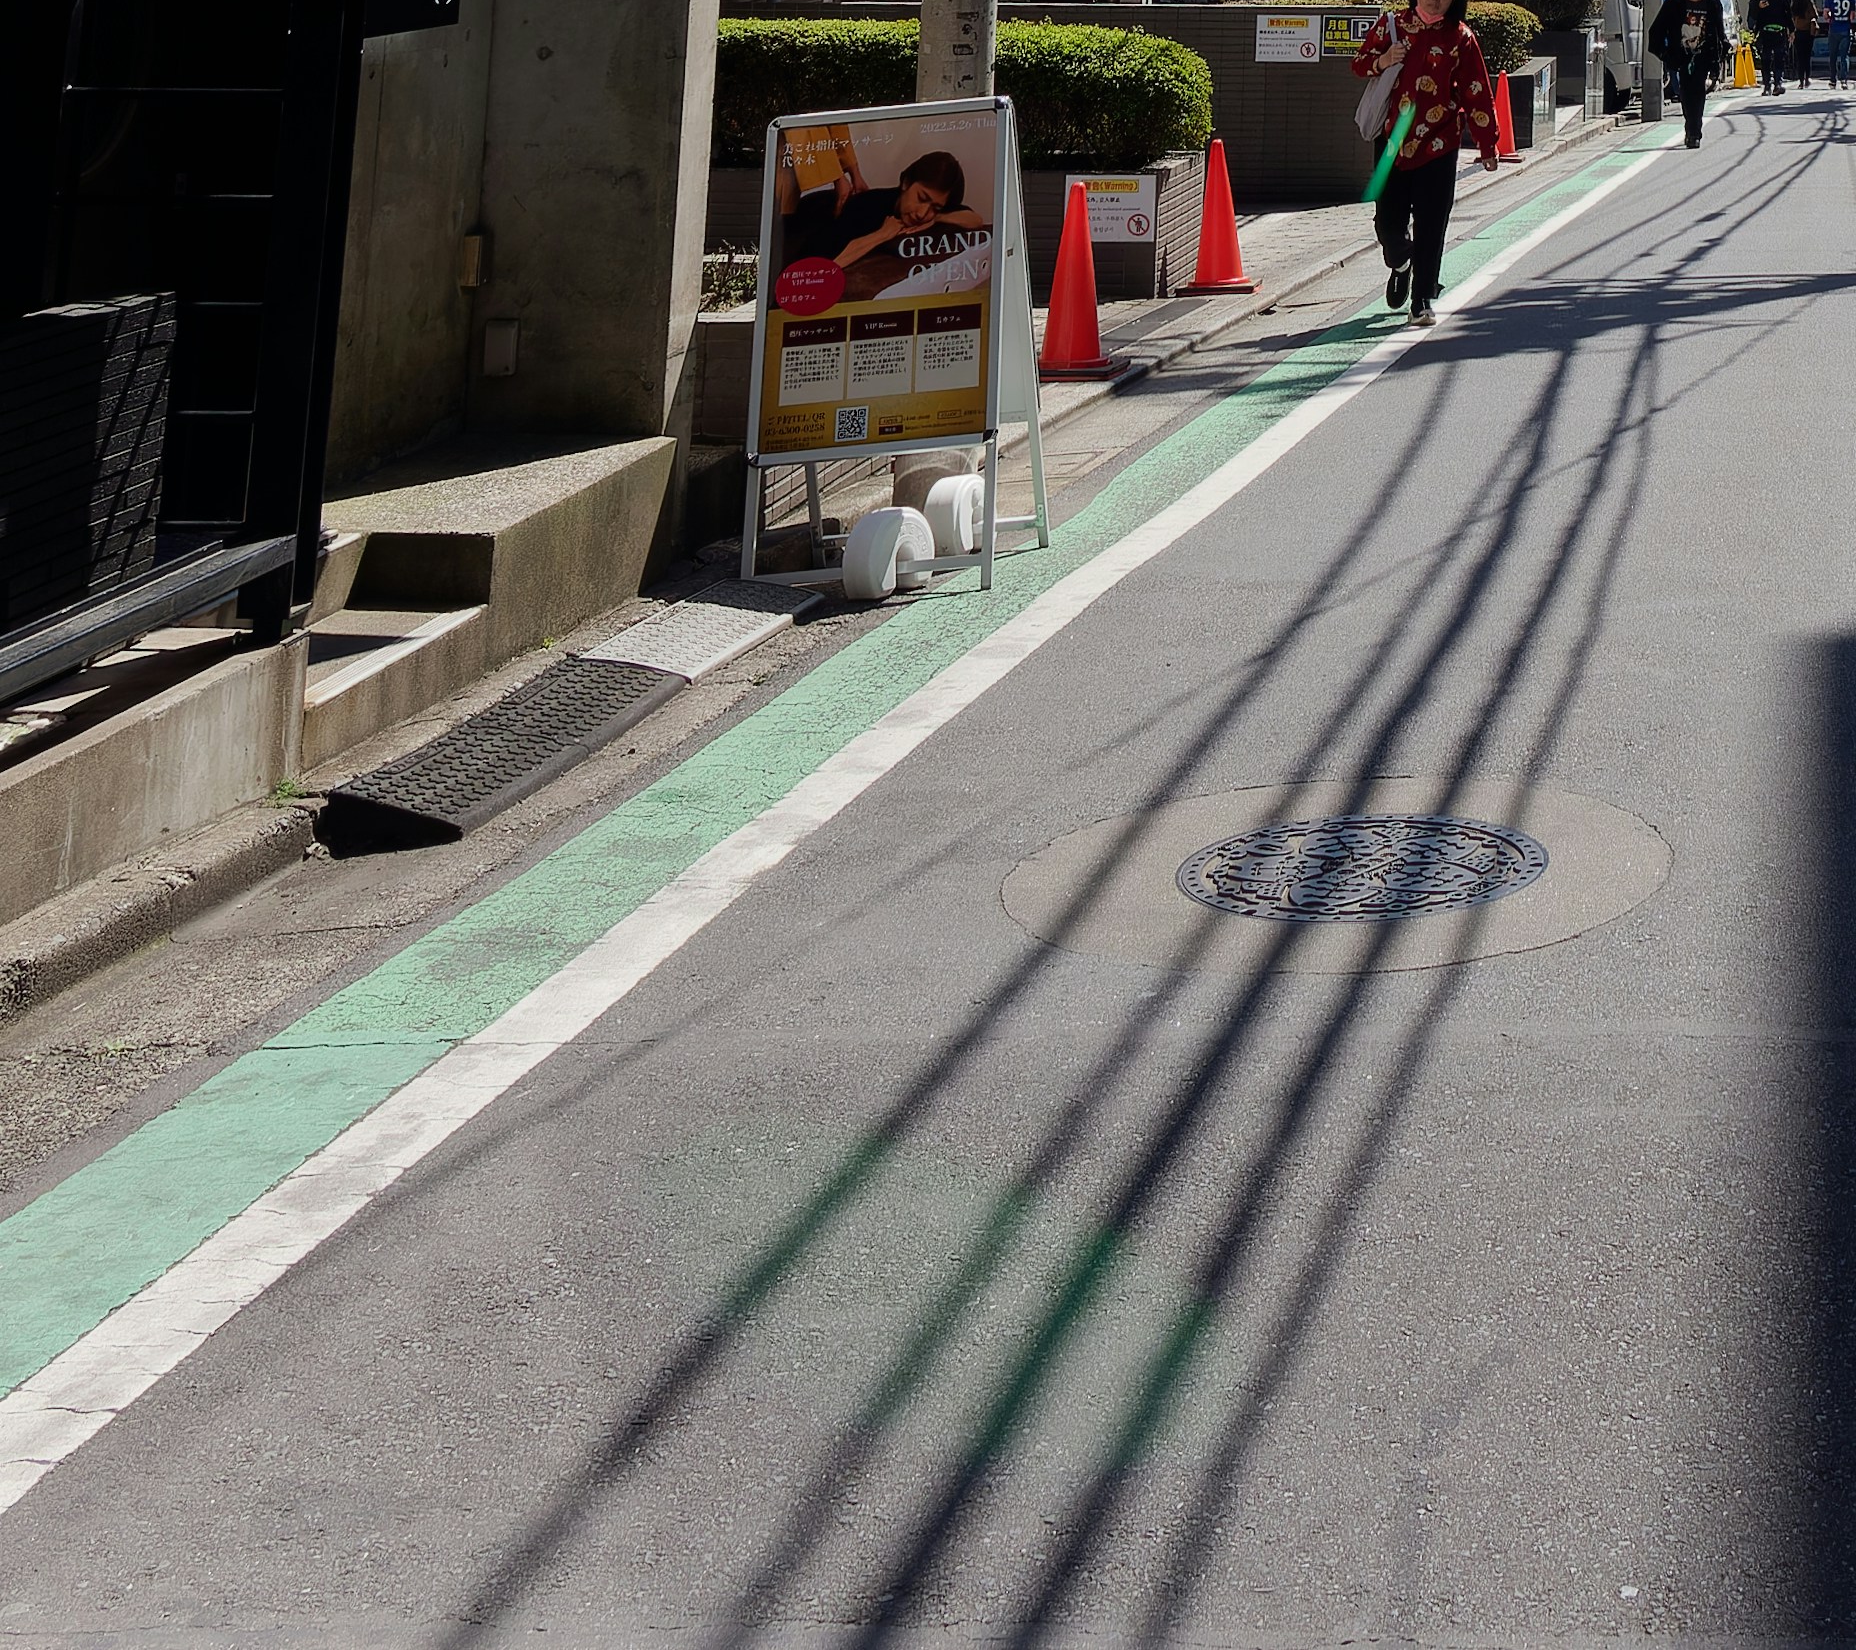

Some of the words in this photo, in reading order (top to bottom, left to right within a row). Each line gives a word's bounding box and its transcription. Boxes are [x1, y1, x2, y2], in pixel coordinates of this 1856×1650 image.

[1833, 0, 1850, 16] 39
[1358, 21, 1370, 38] P
[782, 134, 894, 155] 美これ指圧マッサージ
[782, 155, 816, 168] 代々木
[898, 230, 993, 259] GRAND
[908, 258, 980, 284] OPEN
